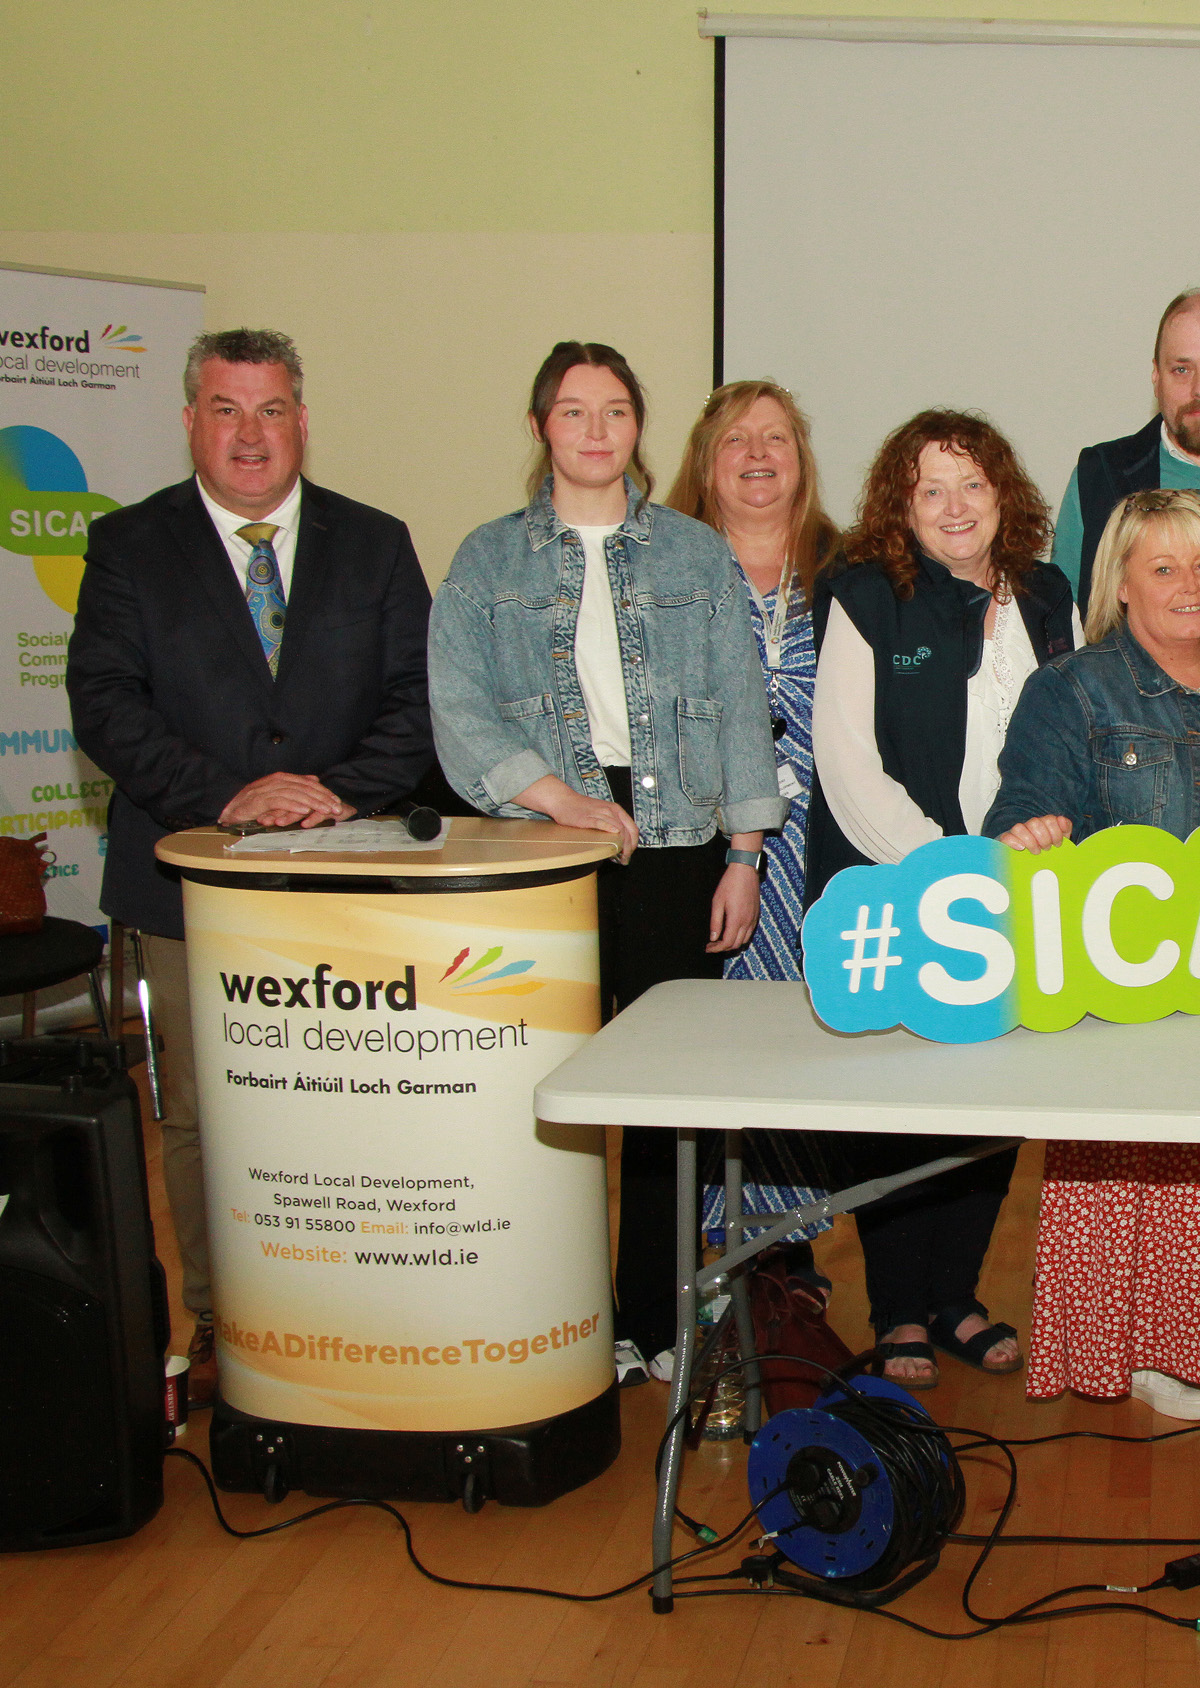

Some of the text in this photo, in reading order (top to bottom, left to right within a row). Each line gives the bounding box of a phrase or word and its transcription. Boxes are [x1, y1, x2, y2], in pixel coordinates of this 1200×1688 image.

[0, 354, 140, 378] cal development
[0, 374, 26, 384] rbairt
[58, 378, 78, 388] Loch
[81, 380, 116, 390] Garman
[10, 509, 107, 537] SICA
[17, 631, 69, 647] Social
[220, 963, 416, 1011] wexford
[224, 1012, 528, 1060] local development
[227, 1069, 477, 1095] Forbairt Áitiúil Loch Garman
[249, 1167, 475, 1191] Wexford Local Development,
[274, 1193, 456, 1213] Spawell Road, Wexford
[231, 1208, 511, 1236] Tel: 053 91 55800 Email: info@wld.ie
[261, 1241, 479, 1266] Website: www.wld.ie
[216, 1311, 600, 1365] akeADifferenceTogether
